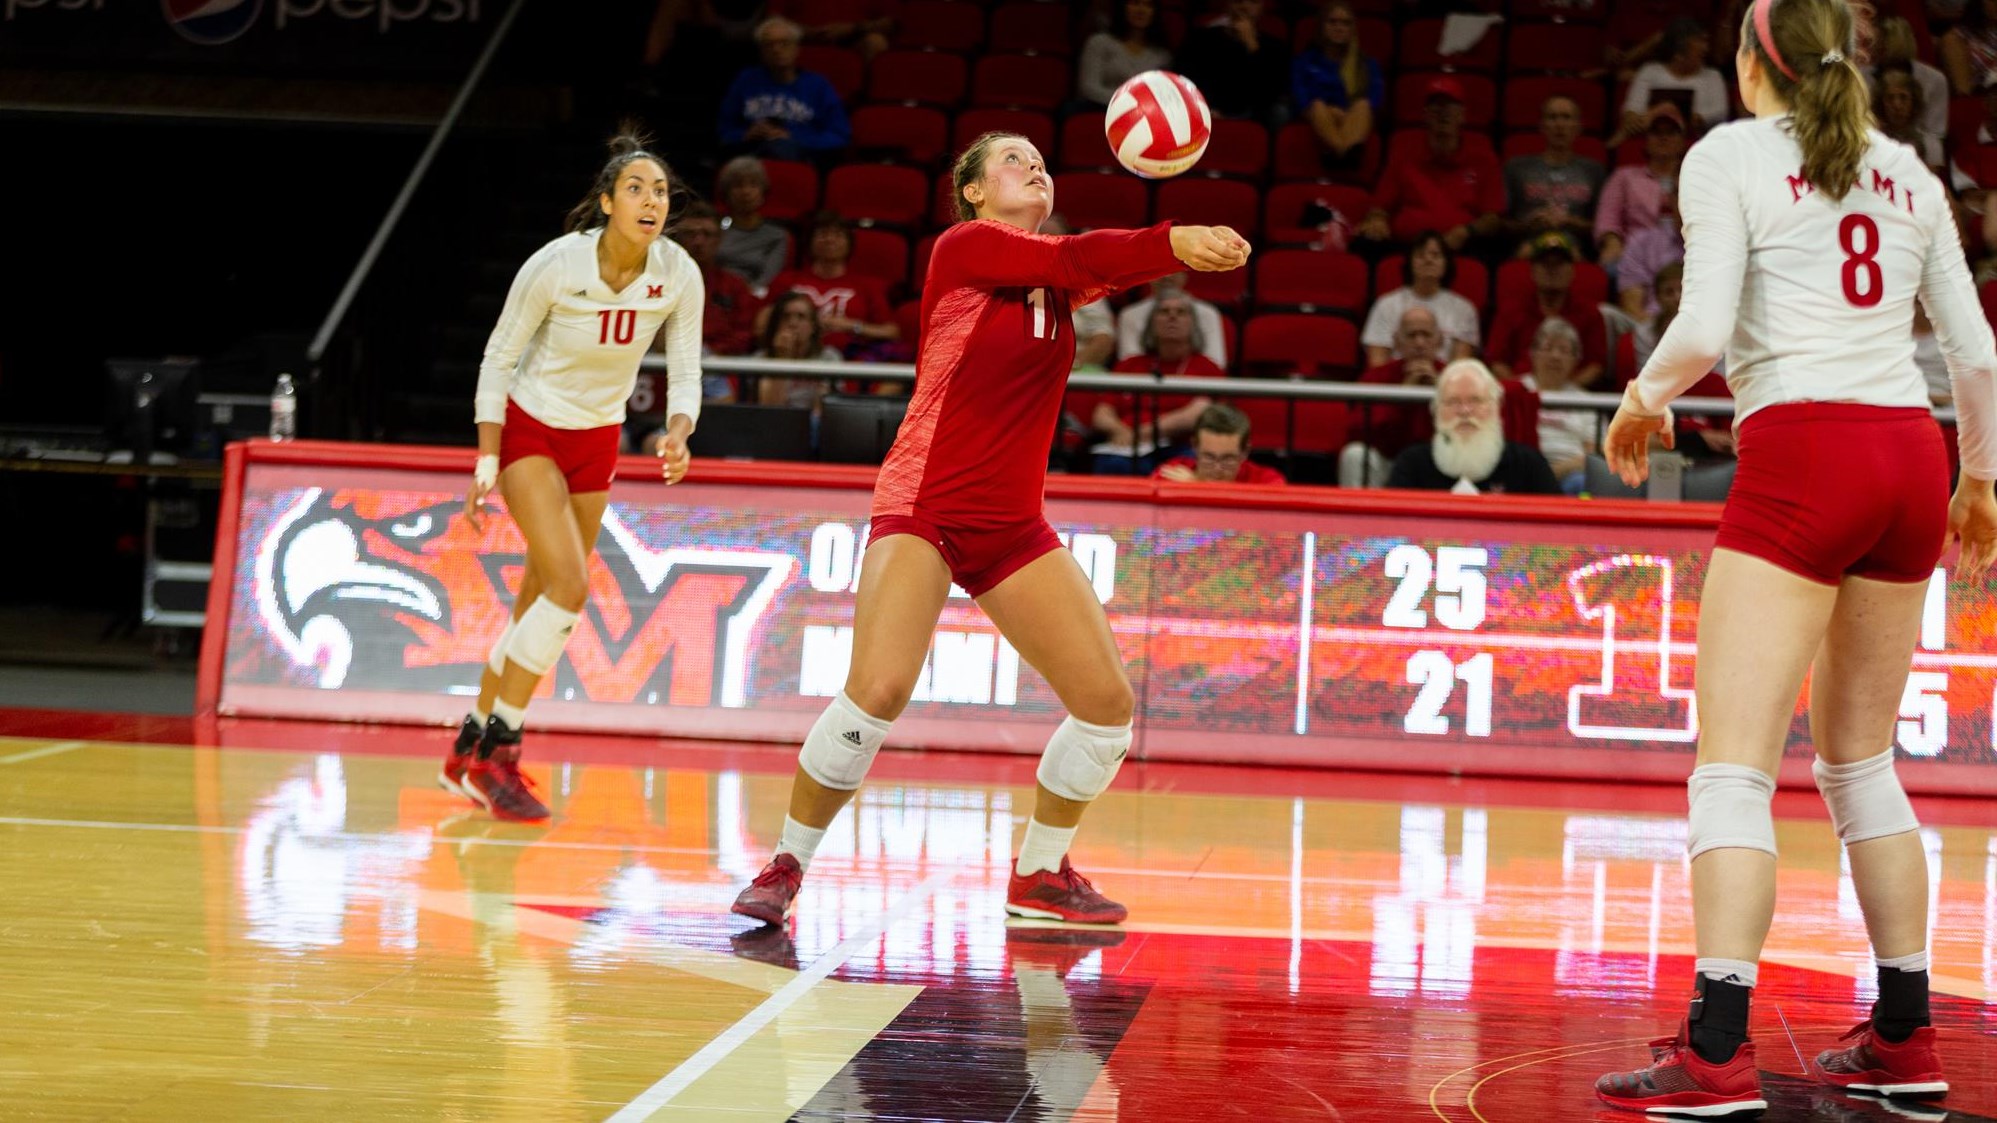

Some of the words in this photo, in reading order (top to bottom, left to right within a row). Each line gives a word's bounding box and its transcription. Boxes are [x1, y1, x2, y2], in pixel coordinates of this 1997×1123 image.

[1785, 167, 1914, 215] MMI
[647, 284, 664, 299] M
[1838, 213, 1884, 309] 8
[597, 309, 637, 345] 10
[1027, 287, 1057, 340] 1
[1382, 544, 1488, 630] 25
[799, 625, 1019, 706] MMI
[1567, 553, 1699, 742] 1
[1404, 649, 1493, 737] 21
